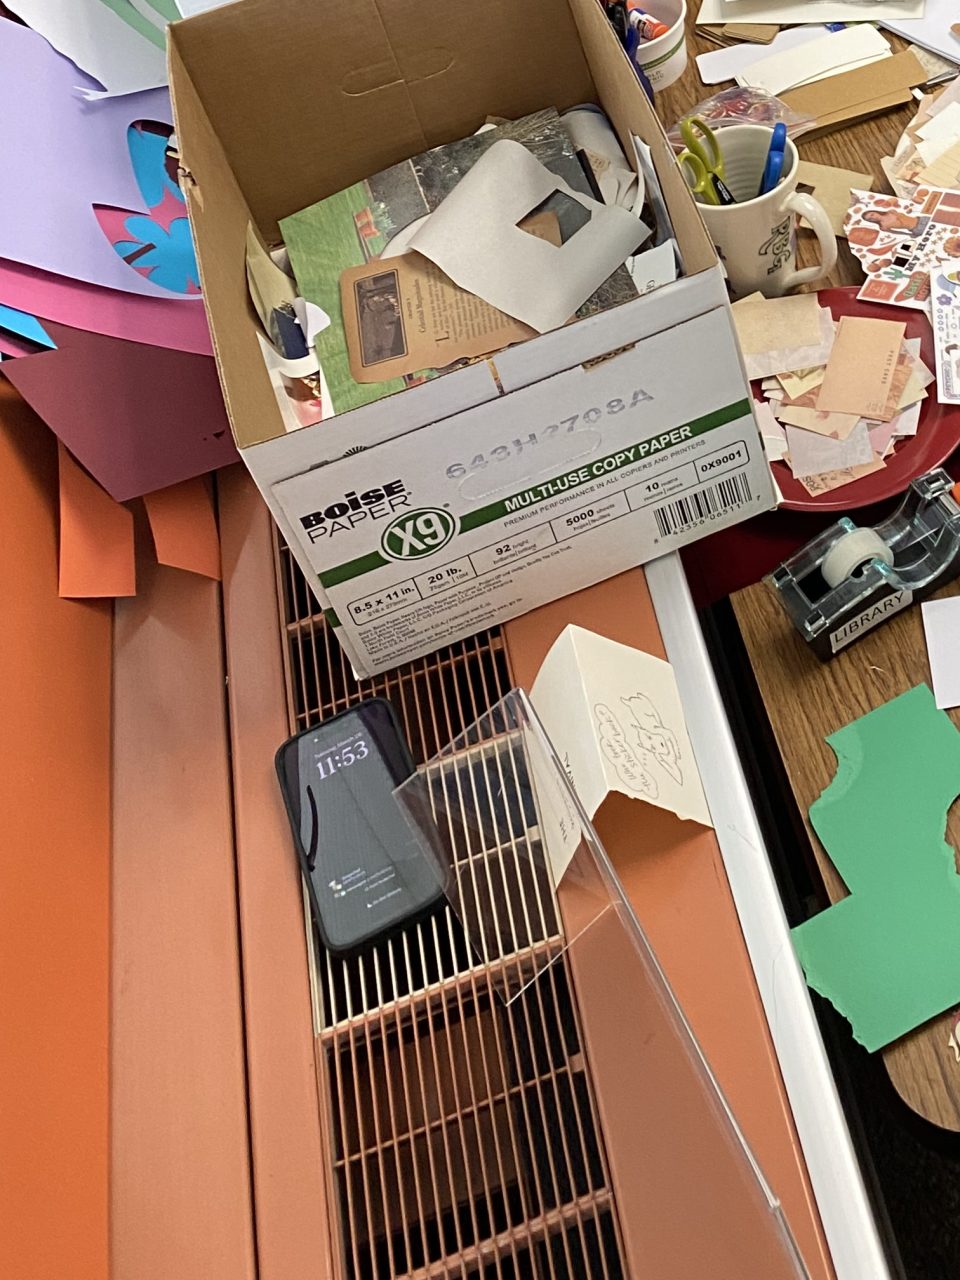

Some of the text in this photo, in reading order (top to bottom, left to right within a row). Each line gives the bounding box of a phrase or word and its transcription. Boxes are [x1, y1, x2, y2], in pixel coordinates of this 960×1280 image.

[504, 426, 693, 513] MULTI-USE COPY PAPER
[701, 451, 742, 473] 0X9001
[503, 439, 706, 527] PREMIUM PERFORMANCE IN ALL COPIERS AND PRINTERS
[645, 482, 660, 493] 10
[307, 494, 411, 544] PAPER
[565, 509, 594, 527] 5000
[672, 520, 705, 536] 42356
[390, 513, 448, 558] X9
[495, 545, 511, 556] 92
[427, 566, 462, 585] 20 lb.
[353, 586, 415, 615] 8.5 x 11 in.
[834, 592, 904, 645] LIBRARY
[316, 741, 369, 780] 11:53
